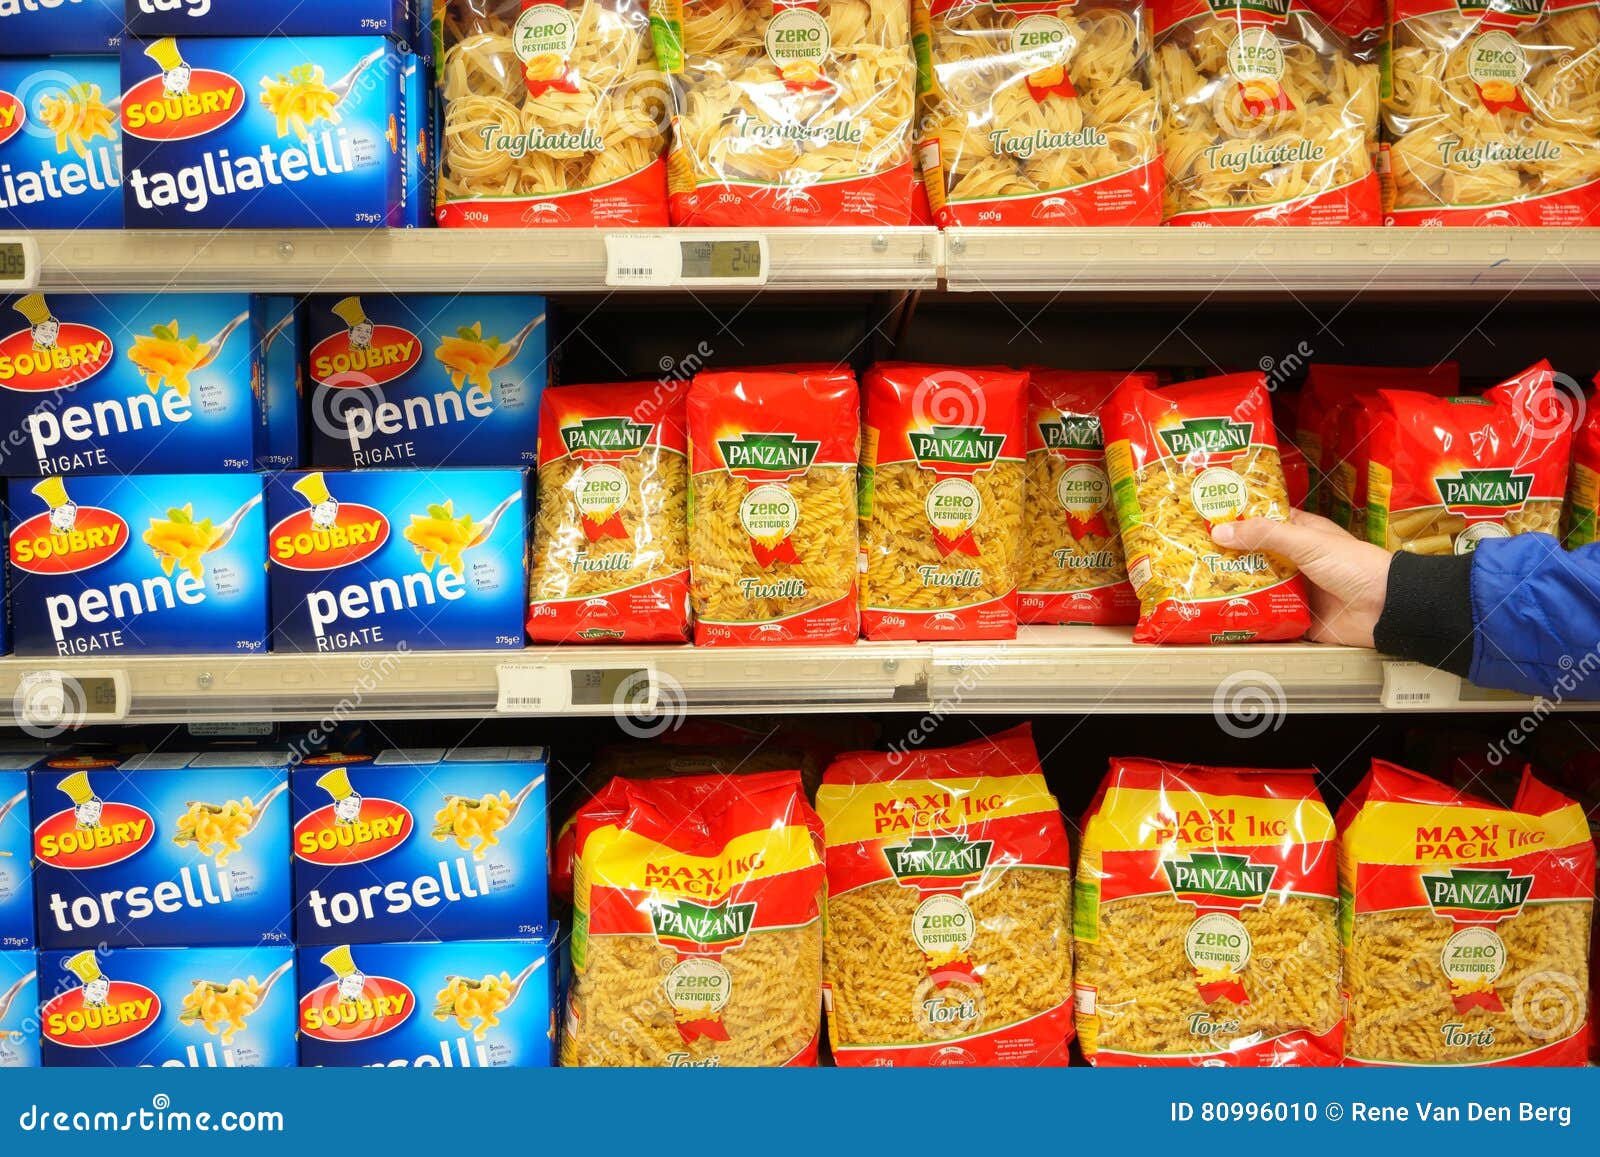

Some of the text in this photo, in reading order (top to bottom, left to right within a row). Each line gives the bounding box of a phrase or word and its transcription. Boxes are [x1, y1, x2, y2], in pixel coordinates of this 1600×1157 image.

[522, 41, 567, 53] PESTICIDES
[775, 47, 822, 59] PESTICIDES
[126, 85, 238, 129] SOUBRY
[481, 126, 603, 156] Tagliatelle
[990, 127, 1107, 157] Tagliatelle
[1207, 141, 1324, 172] Tagliatelle
[1439, 140, 1560, 165] Tagliatelle
[131, 127, 354, 212] tagliatelli
[719, 193, 741, 205] 500g
[464, 211, 489, 222] 500g
[978, 211, 1002, 222] 500g
[0, 340, 105, 380] SOUBRY
[315, 340, 414, 378] SOUBRY
[28, 388, 193, 460] penne
[344, 385, 494, 452] penne
[569, 428, 643, 448] PANZANI
[1049, 427, 1101, 445] PANZA
[1172, 430, 1246, 453] PANZANI
[353, 442, 416, 468] RIGATE
[730, 446, 809, 466] PANZANI
[919, 438, 994, 459] PANZANI
[38, 448, 108, 475] RIGATE
[581, 495, 621, 505] PESTICIDES
[1065, 496, 1102, 504] PESTICIDES
[1447, 481, 1525, 502] PANZANI
[934, 511, 972, 520] PESTICIDES
[1201, 499, 1241, 511] PESTICIDES
[749, 519, 790, 529] PESTICIDES
[15, 523, 121, 563] SOUBRY
[275, 519, 382, 560] SOUBRY
[573, 552, 632, 573] Fusilli
[1055, 550, 1113, 568] Fusilli
[1204, 554, 1267, 573] Fusilli
[920, 566, 981, 586] Fusilli
[741, 579, 807, 599] Fusilli
[46, 570, 206, 641] penne
[307, 567, 466, 637] penne
[534, 606, 557, 618] 500g
[1022, 598, 1044, 608] 500g
[881, 615, 905, 627] 500g
[56, 630, 124, 656] RIGATE
[316, 626, 384, 652] RIGATE
[707, 628, 731, 639] 500g
[874, 793, 950, 817] MAXI
[875, 808, 951, 834] PACK
[1156, 808, 1236, 826] MAXI
[40, 819, 147, 857] SOUBRY
[299, 813, 406, 853] SOUBRY
[1156, 825, 1236, 844] PACK
[1416, 824, 1499, 843] MAXI
[897, 848, 981, 873] PANZANI
[1416, 841, 1499, 859] PACK
[646, 863, 723, 882] MAXI
[1176, 866, 1263, 891] PANZANI
[50, 861, 233, 932] torselli
[309, 857, 489, 928] torselli
[645, 876, 724, 896] PACK
[1435, 881, 1523, 904] PANZANI
[660, 909, 745, 936] PANZANI
[923, 933, 967, 943] PESTICIDES
[1194, 950, 1241, 963] PESTICIDES
[1450, 963, 1496, 973] PESTICIDES
[674, 991, 721, 1002] PESTICIDES
[48, 998, 154, 1036] SOUBRY
[304, 993, 408, 1030] SOUBRY
[924, 999, 975, 1022] Torti
[1442, 1025, 1494, 1046] Torti
